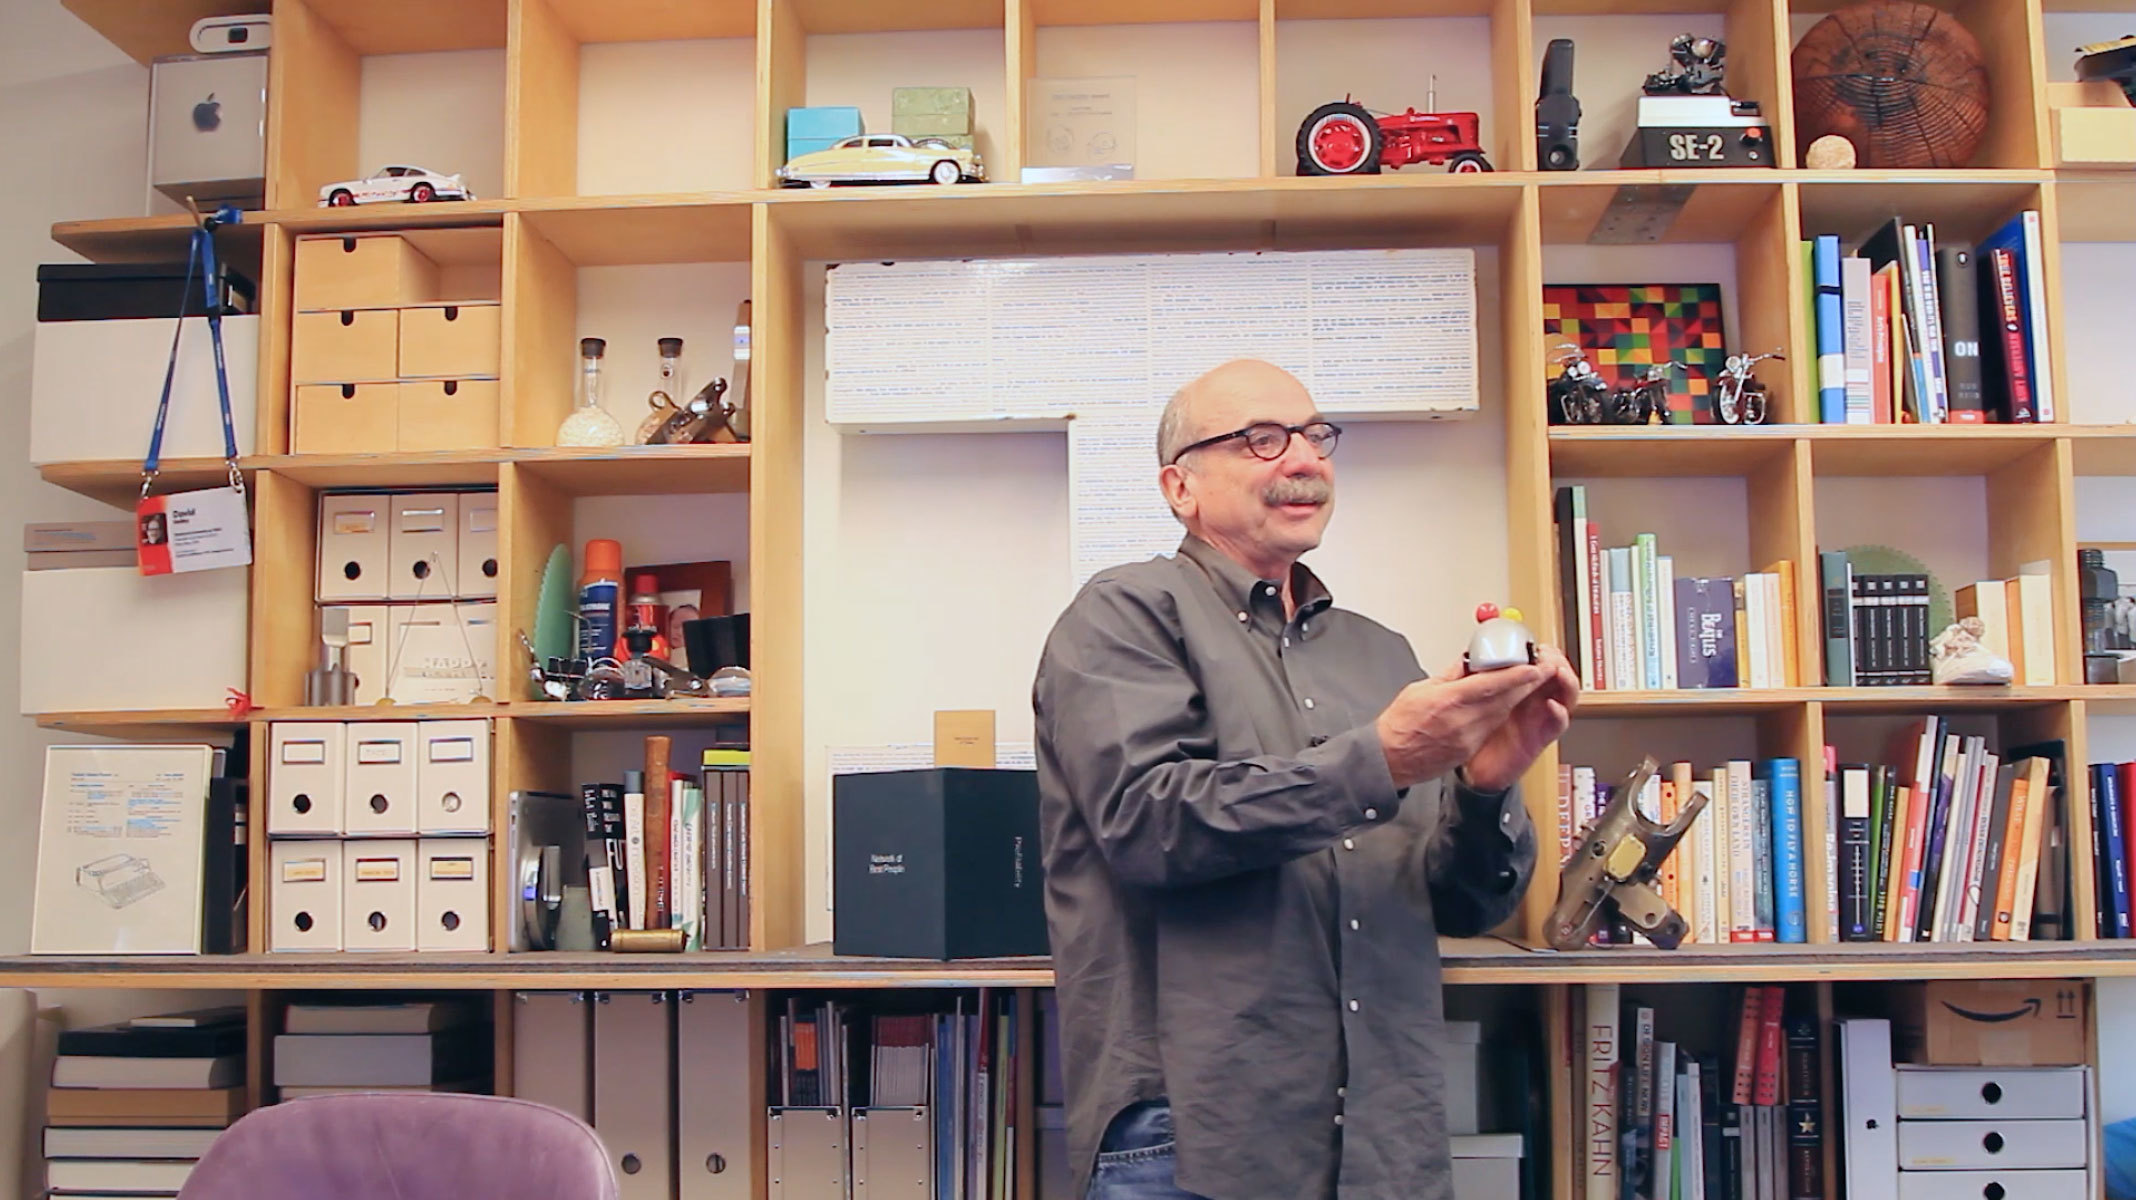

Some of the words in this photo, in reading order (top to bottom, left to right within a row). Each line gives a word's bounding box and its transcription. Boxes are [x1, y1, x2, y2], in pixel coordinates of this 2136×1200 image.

[1669, 134, 1725, 161] SE-2
[1954, 340, 1979, 357] ON
[173, 508, 195, 518] David
[1699, 613, 1723, 657] BEATLES
[1785, 790, 1796, 815] HOW
[1786, 819, 1797, 832] TO
[1787, 834, 1797, 850] FLY
[1788, 863, 1799, 898] HORSE
[1592, 1024, 1613, 1095] FRITZ
[1592, 1103, 1613, 1177] KAHN
[1658, 1116, 1669, 1148] IMPACT
